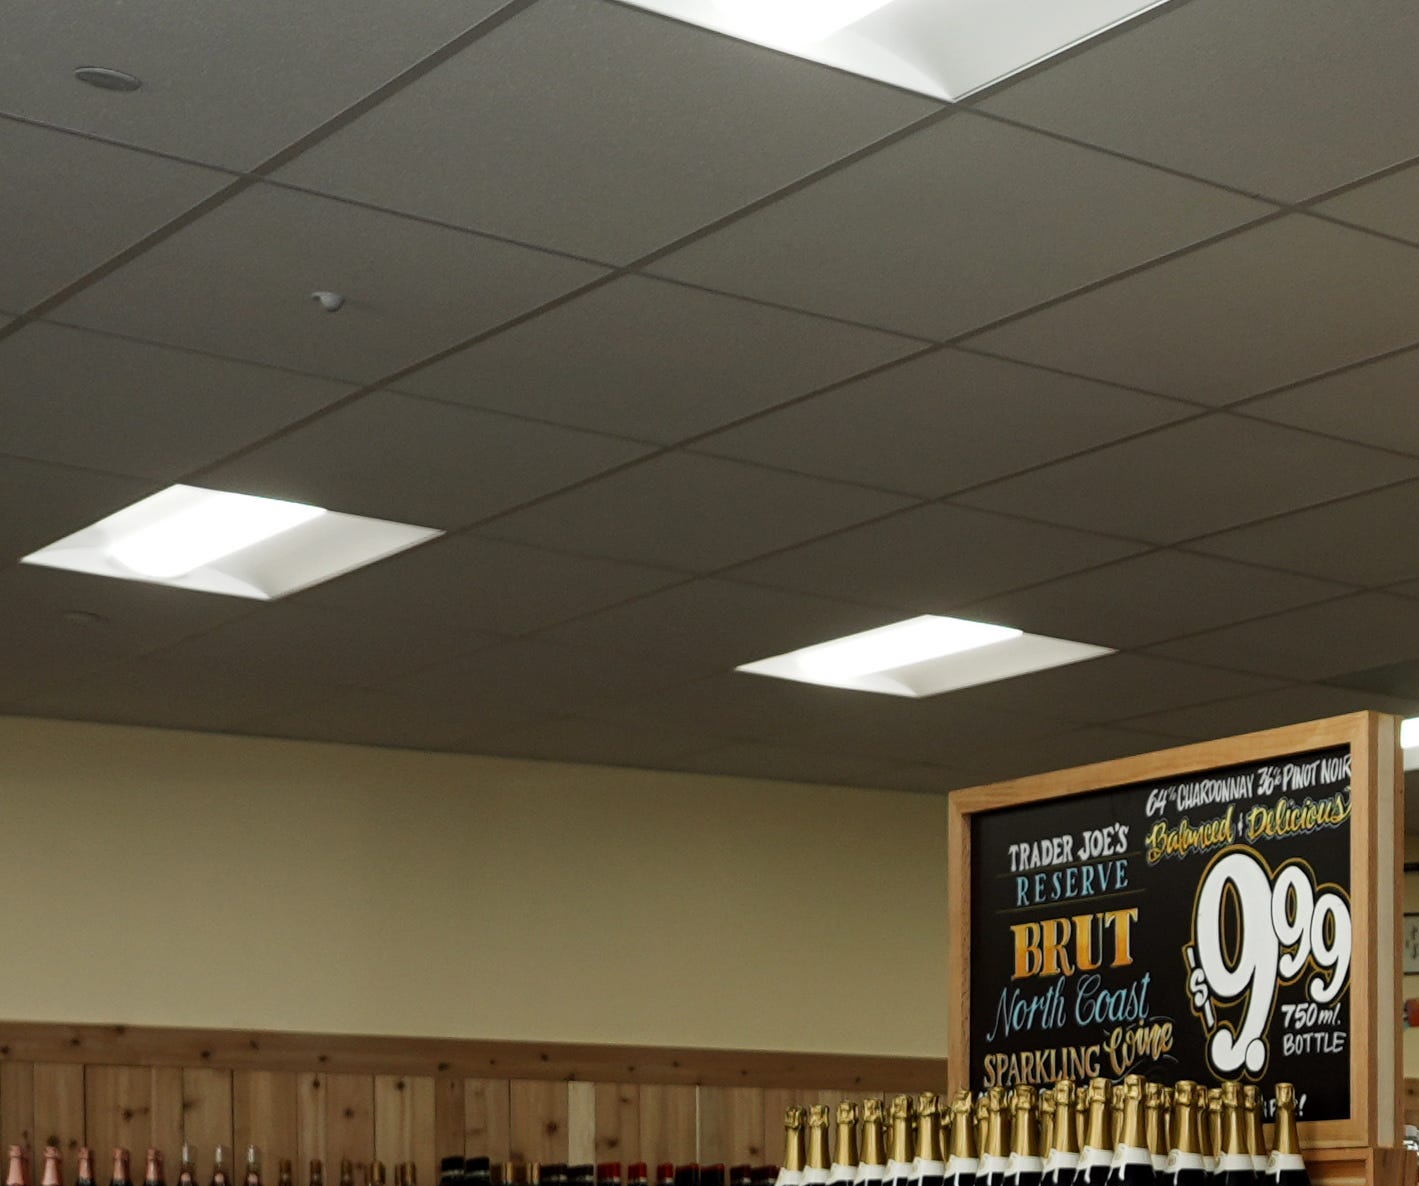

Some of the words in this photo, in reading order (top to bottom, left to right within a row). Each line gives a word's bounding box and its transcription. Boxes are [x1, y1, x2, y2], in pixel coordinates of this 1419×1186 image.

[1177, 774, 1254, 811] CHARDONNAY
[1282, 760, 1320, 792] PINOT
[1008, 834, 1074, 872] TRADER
[1078, 823, 1129, 861] JOE'S
[1146, 804, 1233, 863] Balanced
[1016, 859, 1129, 906] RESERVE
[1010, 908, 1138, 980] BRUT
[986, 975, 1066, 1042] North
[1076, 972, 1150, 1027] Coast
[983, 1044, 1100, 1088] SPARKLING
[1103, 1019, 1174, 1076] Wine
[1283, 1032, 1345, 1055] BOTTLE
